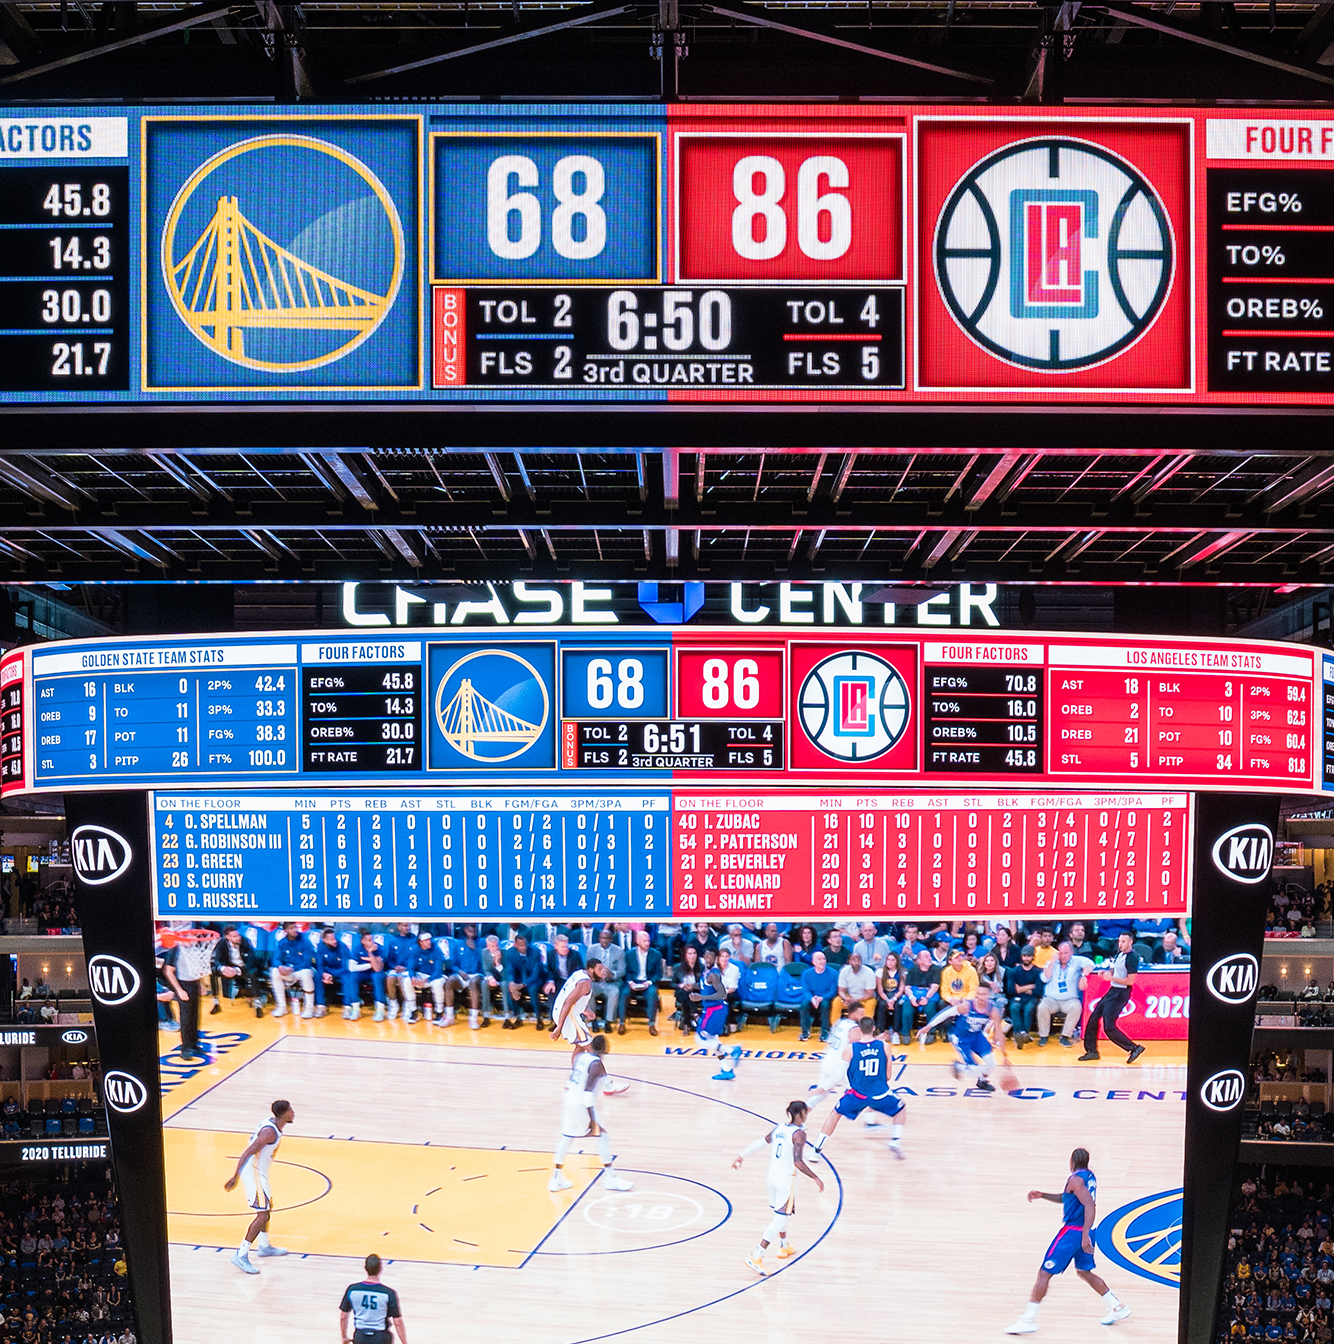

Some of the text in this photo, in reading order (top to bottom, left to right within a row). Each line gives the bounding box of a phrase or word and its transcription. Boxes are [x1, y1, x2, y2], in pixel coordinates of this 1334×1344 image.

[1245, 126, 1312, 154] FOUR
[43, 183, 111, 217] 45.8
[487, 155, 607, 259] 68
[732, 155, 852, 260] 86
[49, 236, 111, 270] 14.3
[41, 289, 111, 323] 30.0
[479, 295, 573, 327] TOL 2
[607, 290, 732, 350] 6:50
[443, 294, 458, 381] BONUS
[51, 342, 112, 375] 21.7
[480, 346, 573, 379] FLS 2
[583, 362, 754, 383] 3rd QUARTER
[82, 650, 224, 668] GOLDEN STATE TEAM STATS
[1126, 650, 1262, 669] LOS ANGELES TEAM STATS
[586, 658, 644, 710] 68
[701, 658, 760, 710] 86
[643, 723, 701, 753] 6:51
[632, 756, 714, 767] 3rd QUARTER
[184, 813, 267, 830] O. SPELLMAN
[716, 813, 760, 829] ZUBAC
[185, 833, 282, 849] G. ROBINSON III
[704, 833, 798, 849] P. PATTERSON
[1228, 836, 1268, 870] KIA
[74, 837, 118, 871] KIA
[186, 853, 242, 869] D. GREEN
[704, 853, 786, 869] P. BEVERLEY
[186, 873, 244, 889] S. CURRY
[704, 873, 781, 889] K. LEONARD
[187, 893, 258, 909] D. RUSSELL
[704, 894, 773, 910] L. SHAMET
[858, 1058, 880, 1077] 40
[361, 1295, 377, 1310] 45
